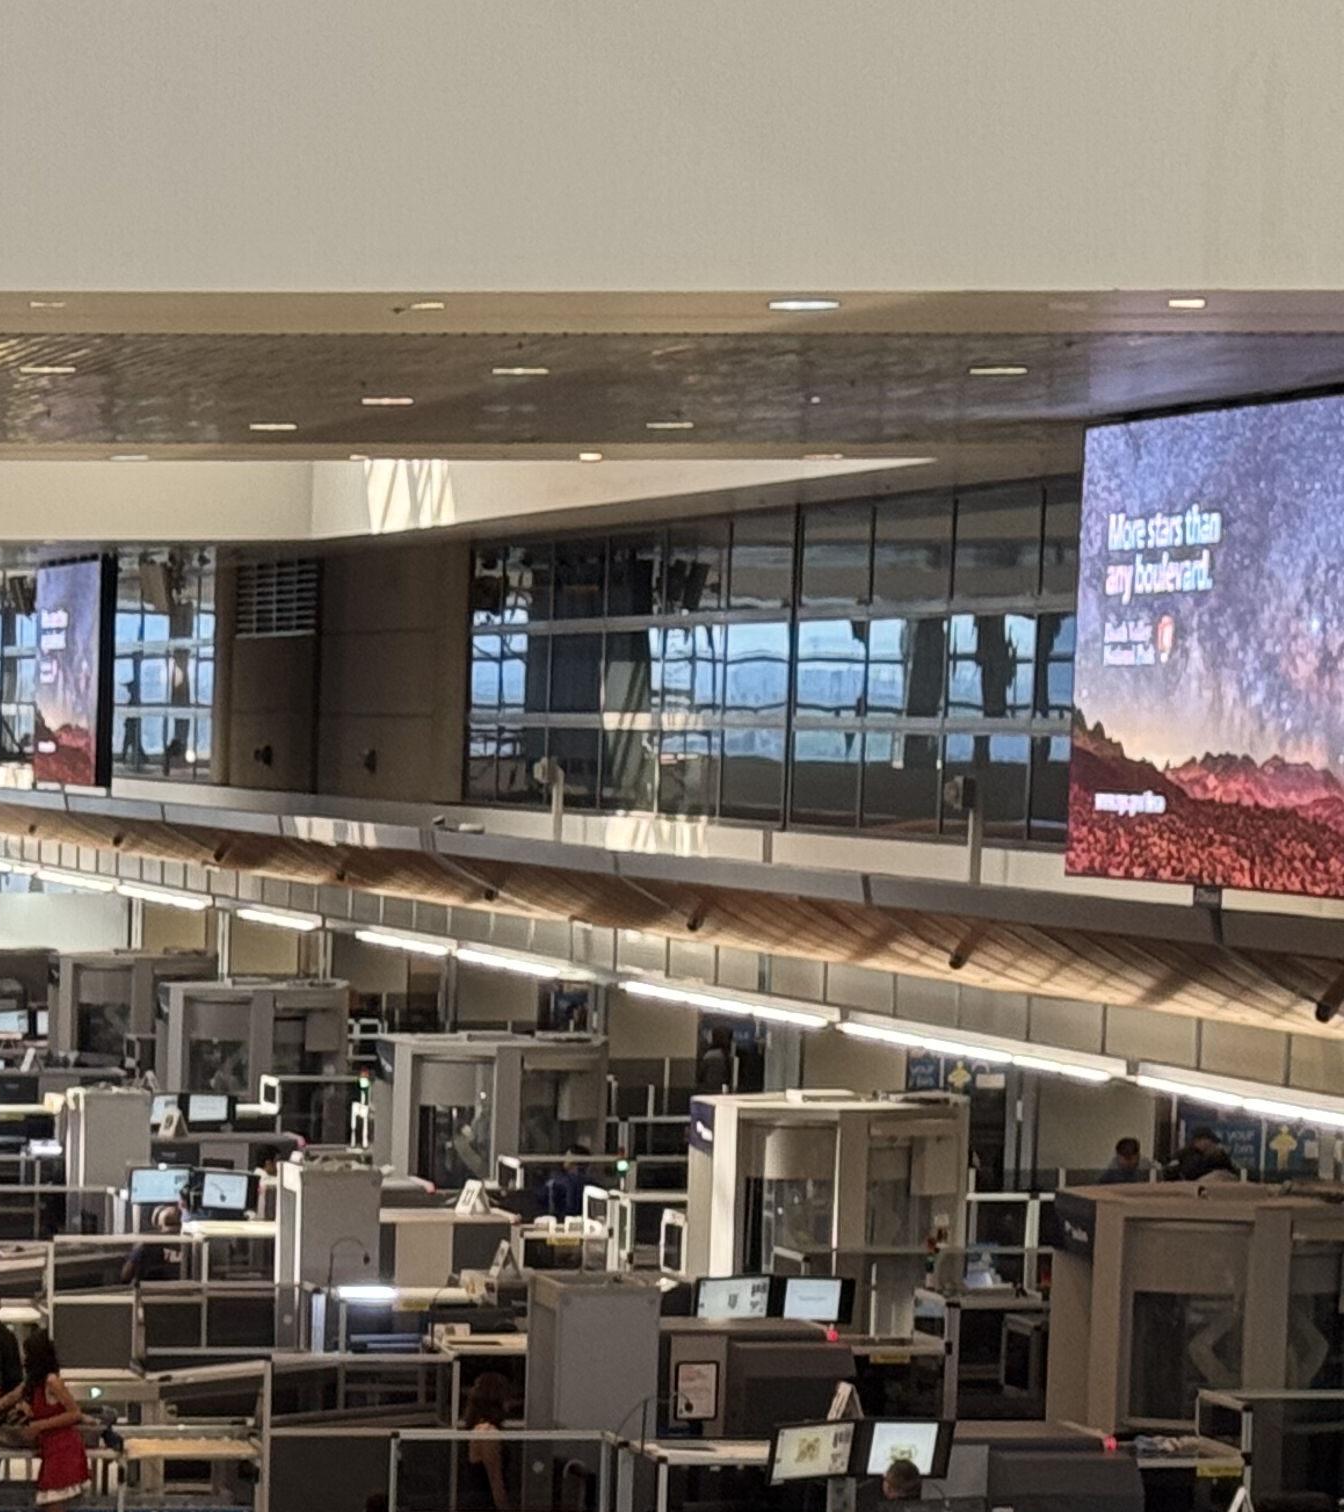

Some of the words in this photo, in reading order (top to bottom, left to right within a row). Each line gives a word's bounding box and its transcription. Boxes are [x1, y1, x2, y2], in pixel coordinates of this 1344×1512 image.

[1108, 513, 1146, 550] More
[1148, 512, 1183, 548] stars
[1185, 504, 1221, 545] than
[1106, 565, 1133, 605] any
[1134, 549, 1213, 593] boulevard.
